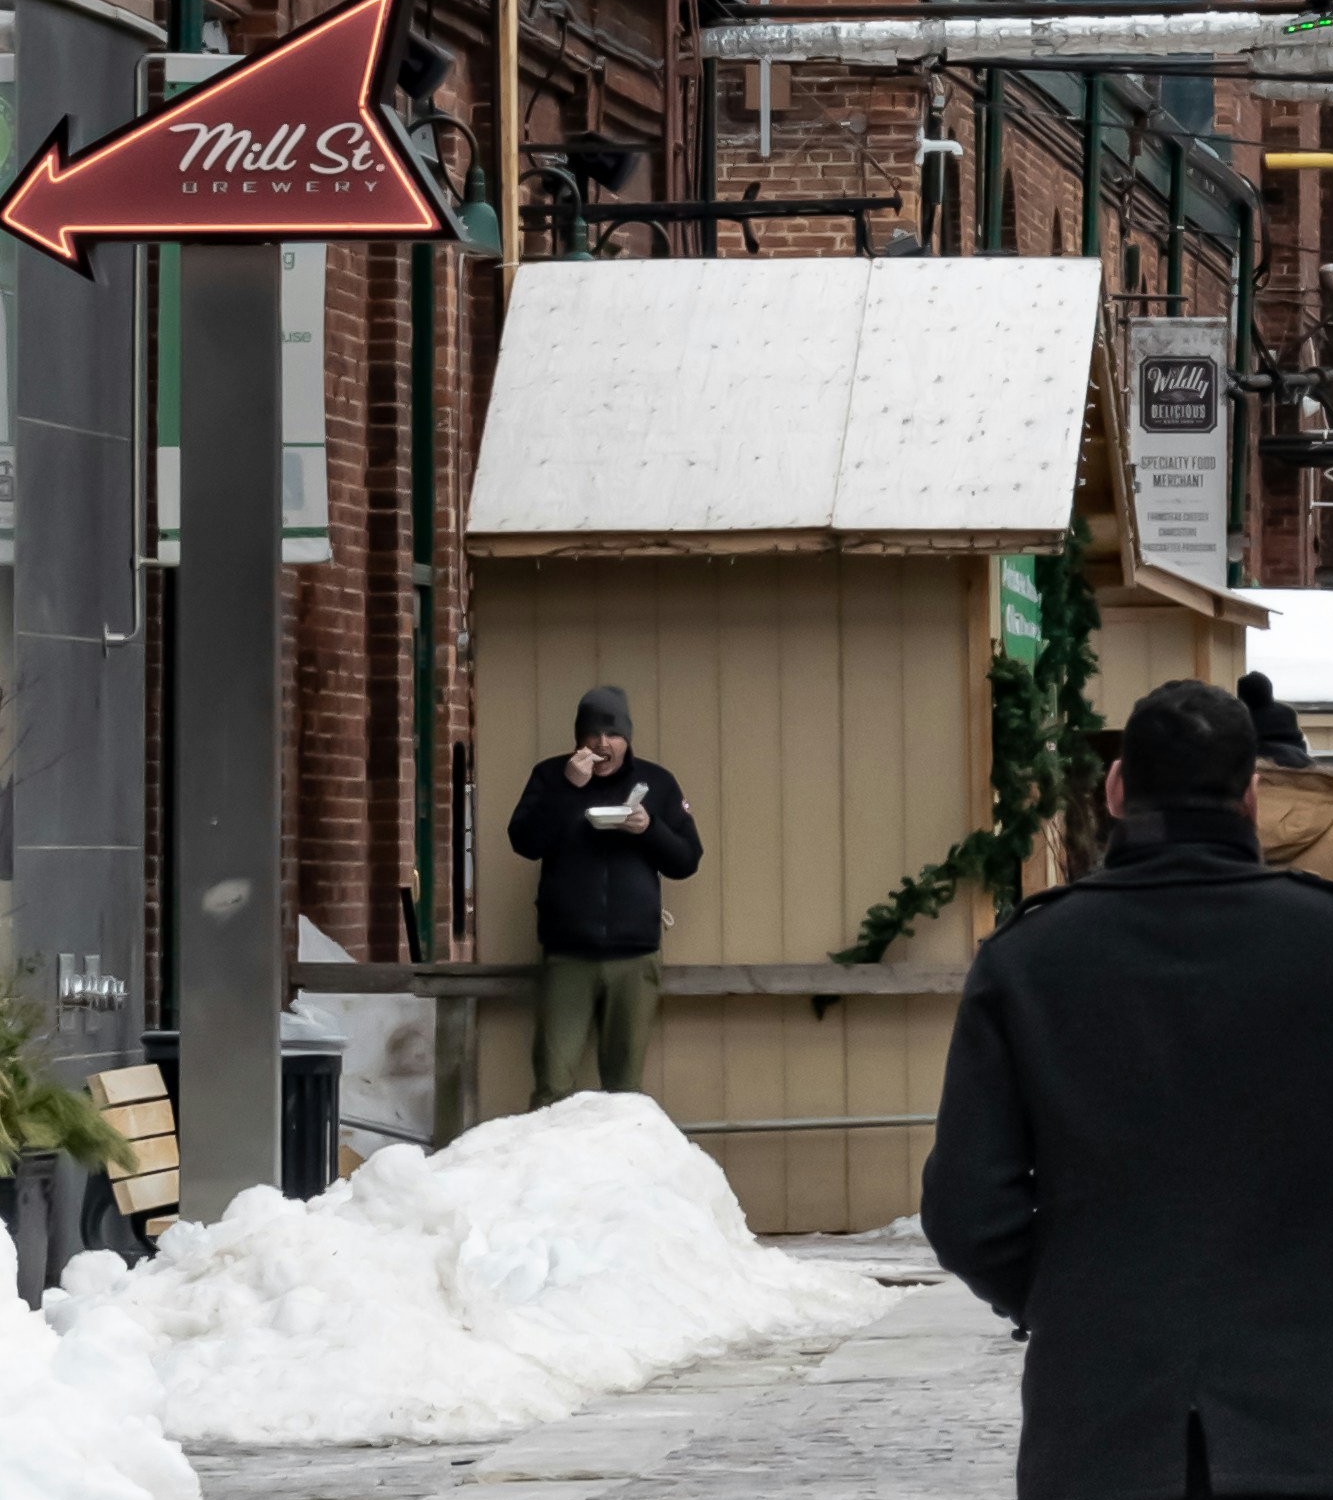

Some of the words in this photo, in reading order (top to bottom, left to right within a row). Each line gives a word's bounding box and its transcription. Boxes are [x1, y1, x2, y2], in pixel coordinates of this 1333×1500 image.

[169, 122, 306, 172] Mill
[310, 122, 385, 175] St.
[182, 181, 378, 193] BREWERY
[1147, 365, 1209, 399] Wildly
[1152, 404, 1205, 419] DELICIOUS
[1141, 456, 1189, 469] SPECIALTY
[1192, 456, 1216, 469] FOOD
[1153, 474, 1203, 487] MERCHANT
